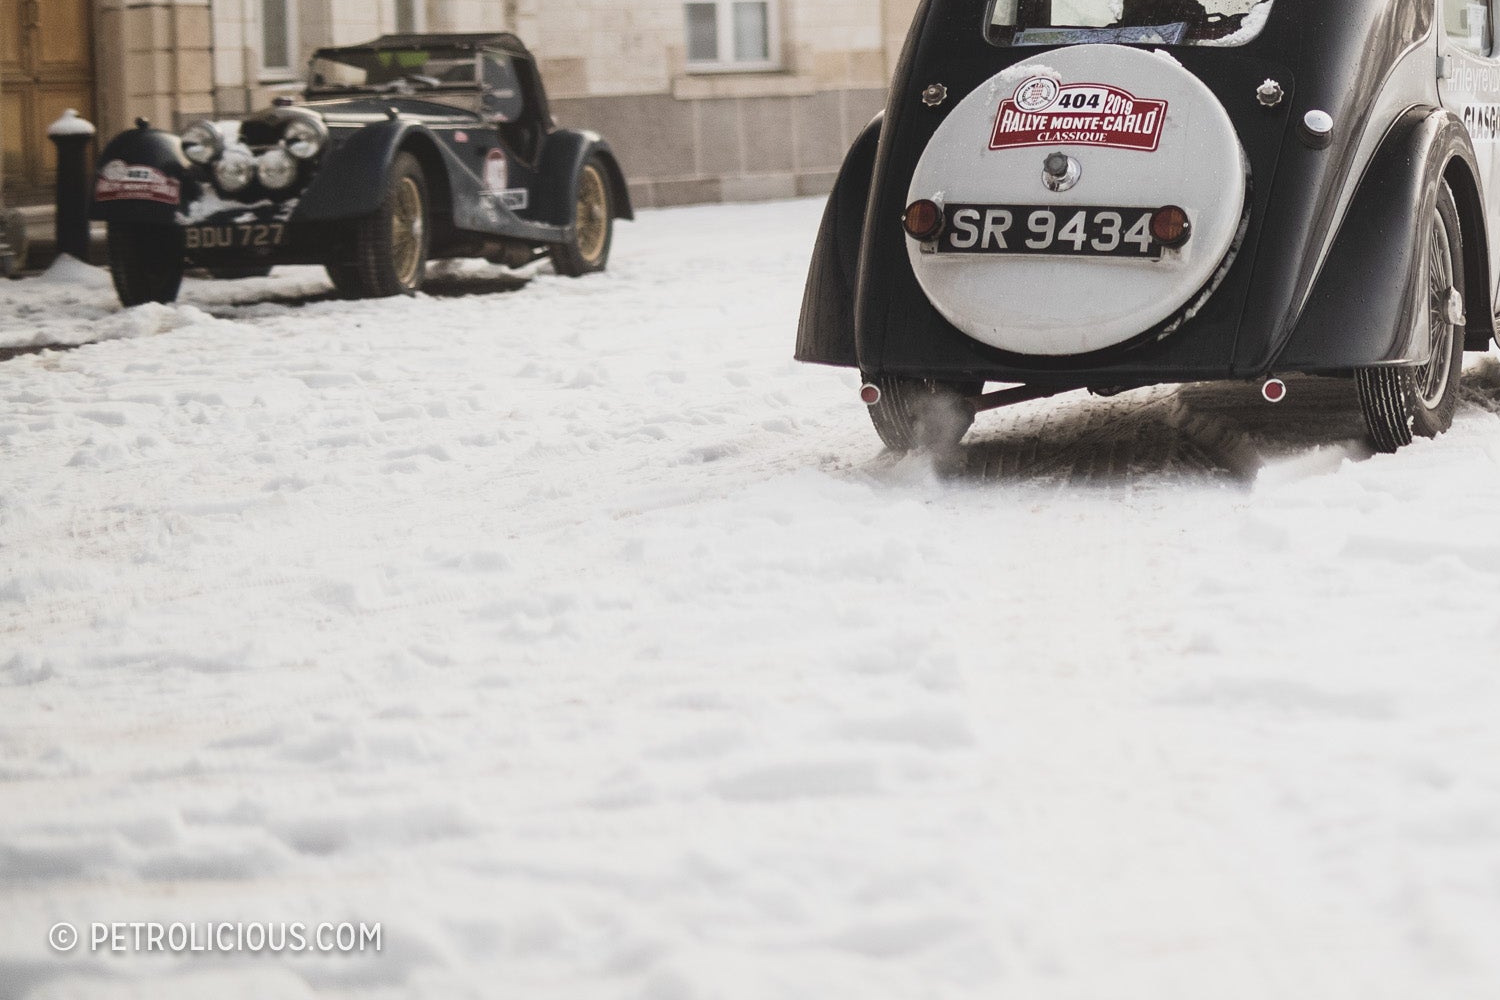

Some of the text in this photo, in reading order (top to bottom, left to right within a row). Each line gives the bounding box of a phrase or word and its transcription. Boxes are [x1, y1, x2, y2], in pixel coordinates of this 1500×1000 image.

[1058, 93, 1100, 109] 404
[1104, 93, 1133, 116] 2019
[1000, 109, 1157, 135] RALLYE MONTE-CARLO
[1037, 131, 1107, 142] CLASSIQUE
[186, 223, 284, 249] BDU 727
[950, 208, 1153, 253] SR 9434
